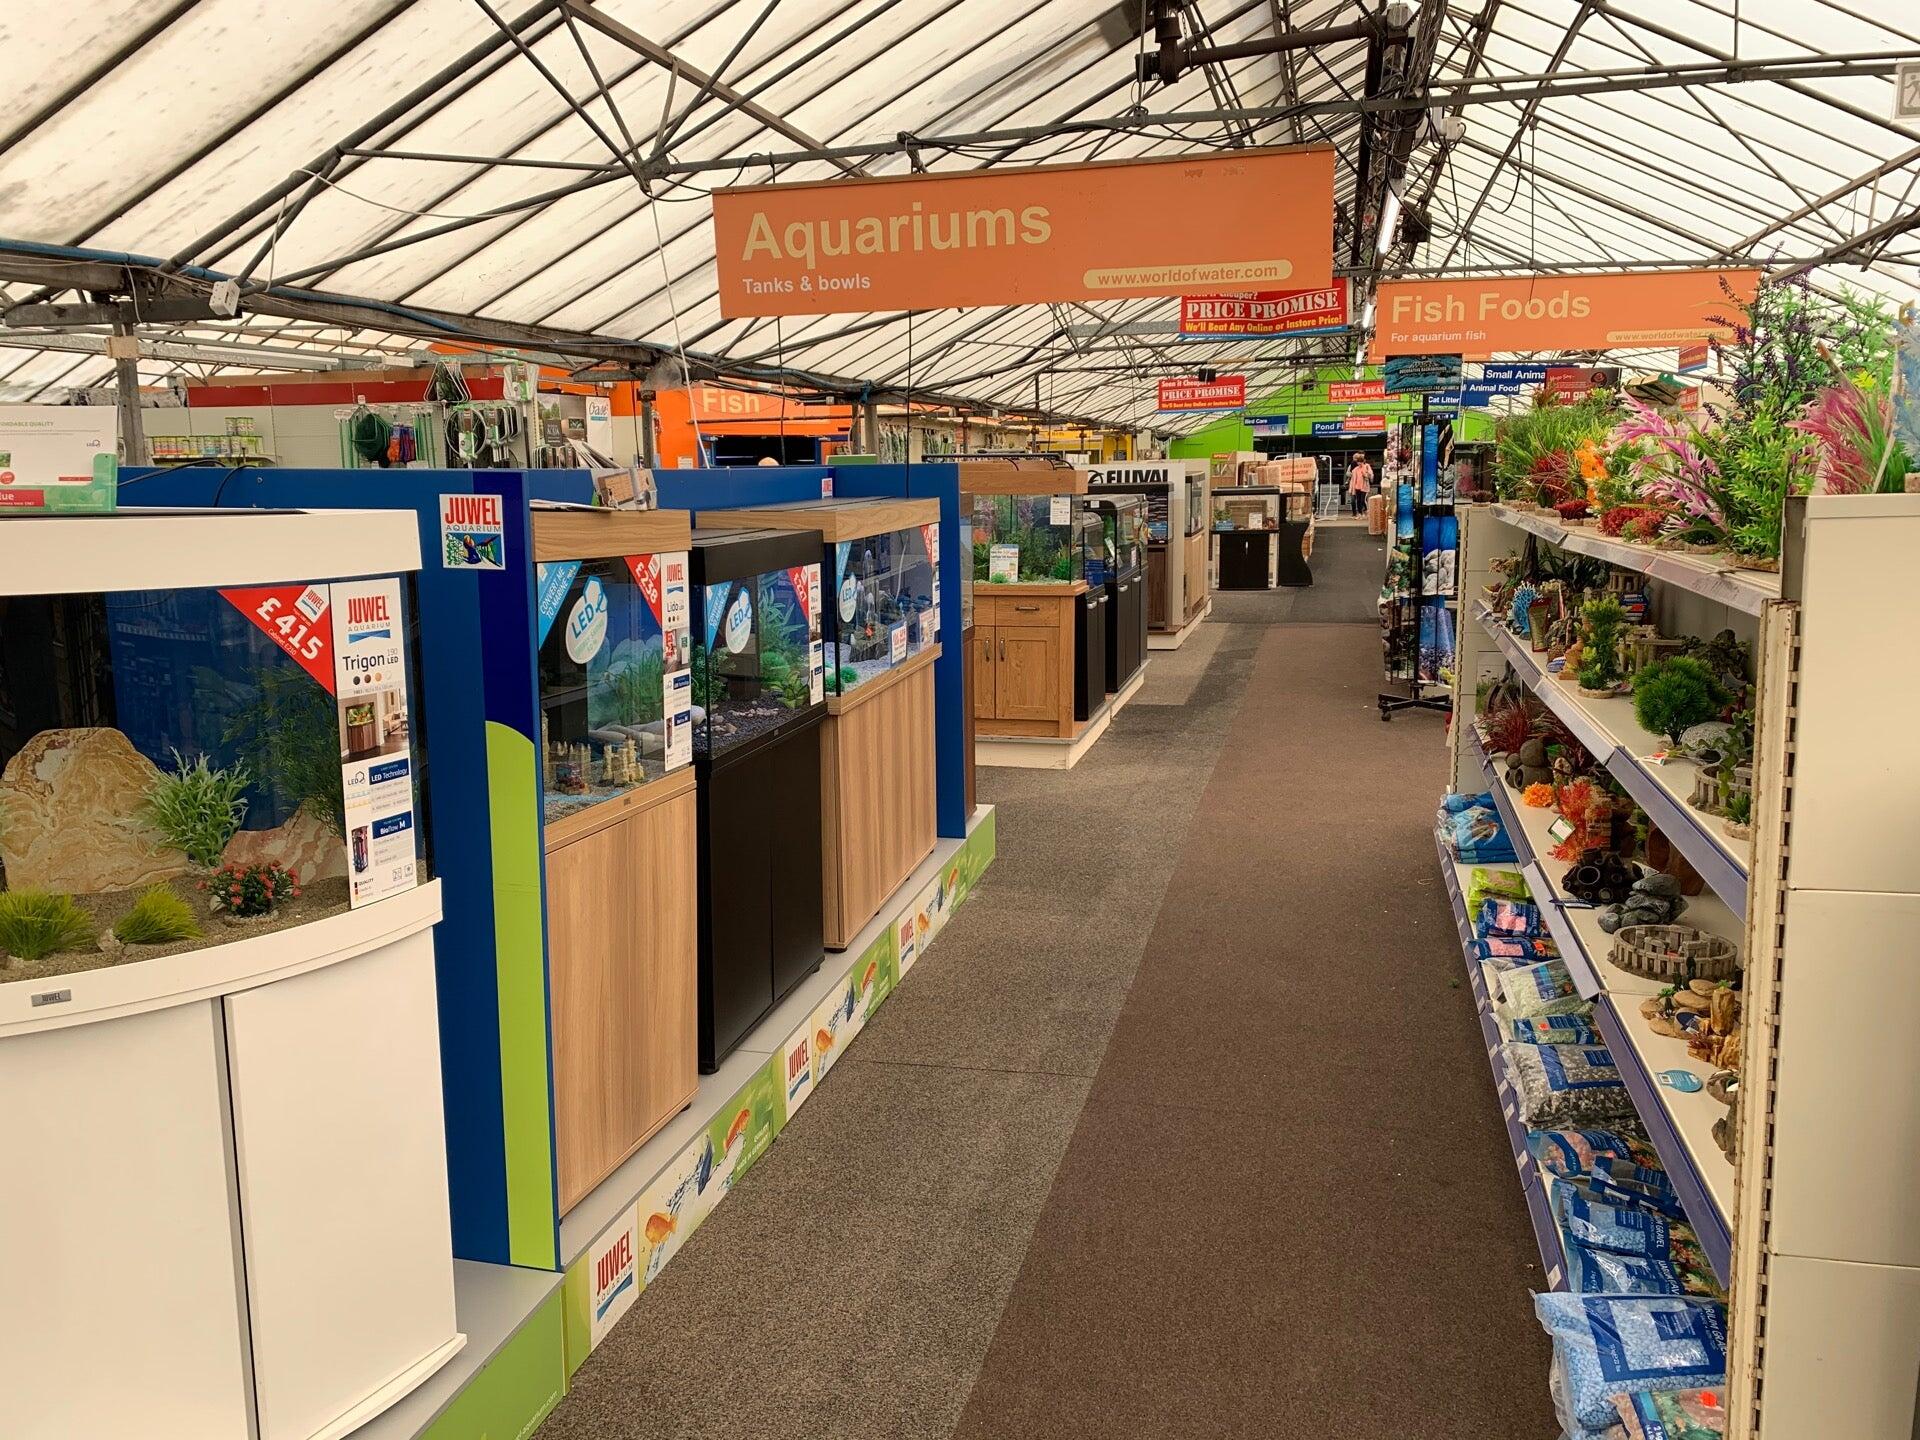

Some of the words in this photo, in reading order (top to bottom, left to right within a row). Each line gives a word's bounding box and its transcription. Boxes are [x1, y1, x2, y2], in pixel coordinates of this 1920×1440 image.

[742, 201, 1053, 270] Aquariums
[742, 276, 794, 294] Tanks
[799, 275, 812, 292] &
[817, 272, 872, 291] bowls
[1097, 262, 1279, 287] www.worldofwater.com
[1186, 301, 1246, 319] PRICE
[1250, 291, 1339, 319] PROMISE
[1391, 294, 1465, 324] Fish
[1478, 289, 1592, 321] Foods
[1208, 322, 1228, 332] Beat
[1229, 322, 1246, 333] Any
[1247, 321, 1273, 332] Online
[1275, 322, 1284, 331] or
[1286, 317, 1317, 329] Instore
[1318, 313, 1343, 325] Price!
[1391, 332, 1409, 343] For
[1412, 330, 1462, 344] aquarium
[1465, 329, 1487, 341] fish
[1486, 369, 1513, 379] Small
[1517, 369, 1546, 379] Anima
[1162, 390, 1193, 400] PRICE
[1194, 386, 1240, 398] PROMISE
[1345, 388, 1364, 396] WILL
[1469, 384, 1496, 392] Animal
[1498, 384, 1519, 392] Food
[702, 389, 760, 416] Fish
[1428, 396, 1440, 404] Cat
[1440, 395, 1460, 404] Litter
[1315, 423, 1335, 431] Pond
[1337, 422, 1345, 430] Fi
[445, 497, 501, 525] JUWEL
[446, 524, 501, 533] AQUARIUM
[635, 561, 658, 604] £238
[666, 563, 684, 582] JUWEL
[306, 589, 325, 610] JUWEL
[347, 595, 390, 624] JUWEL
[666, 601, 678, 612] Lido
[255, 597, 324, 660] £415
[347, 622, 391, 632] AQUARIUM
[342, 653, 385, 672] Trigon
[387, 655, 399, 664] LED
[371, 773, 382, 782] LED
[382, 767, 408, 779] Technology
[900, 916, 914, 949] JUWEL
[788, 1037, 810, 1082] JUWEL
[596, 1230, 633, 1297] JUWEL
